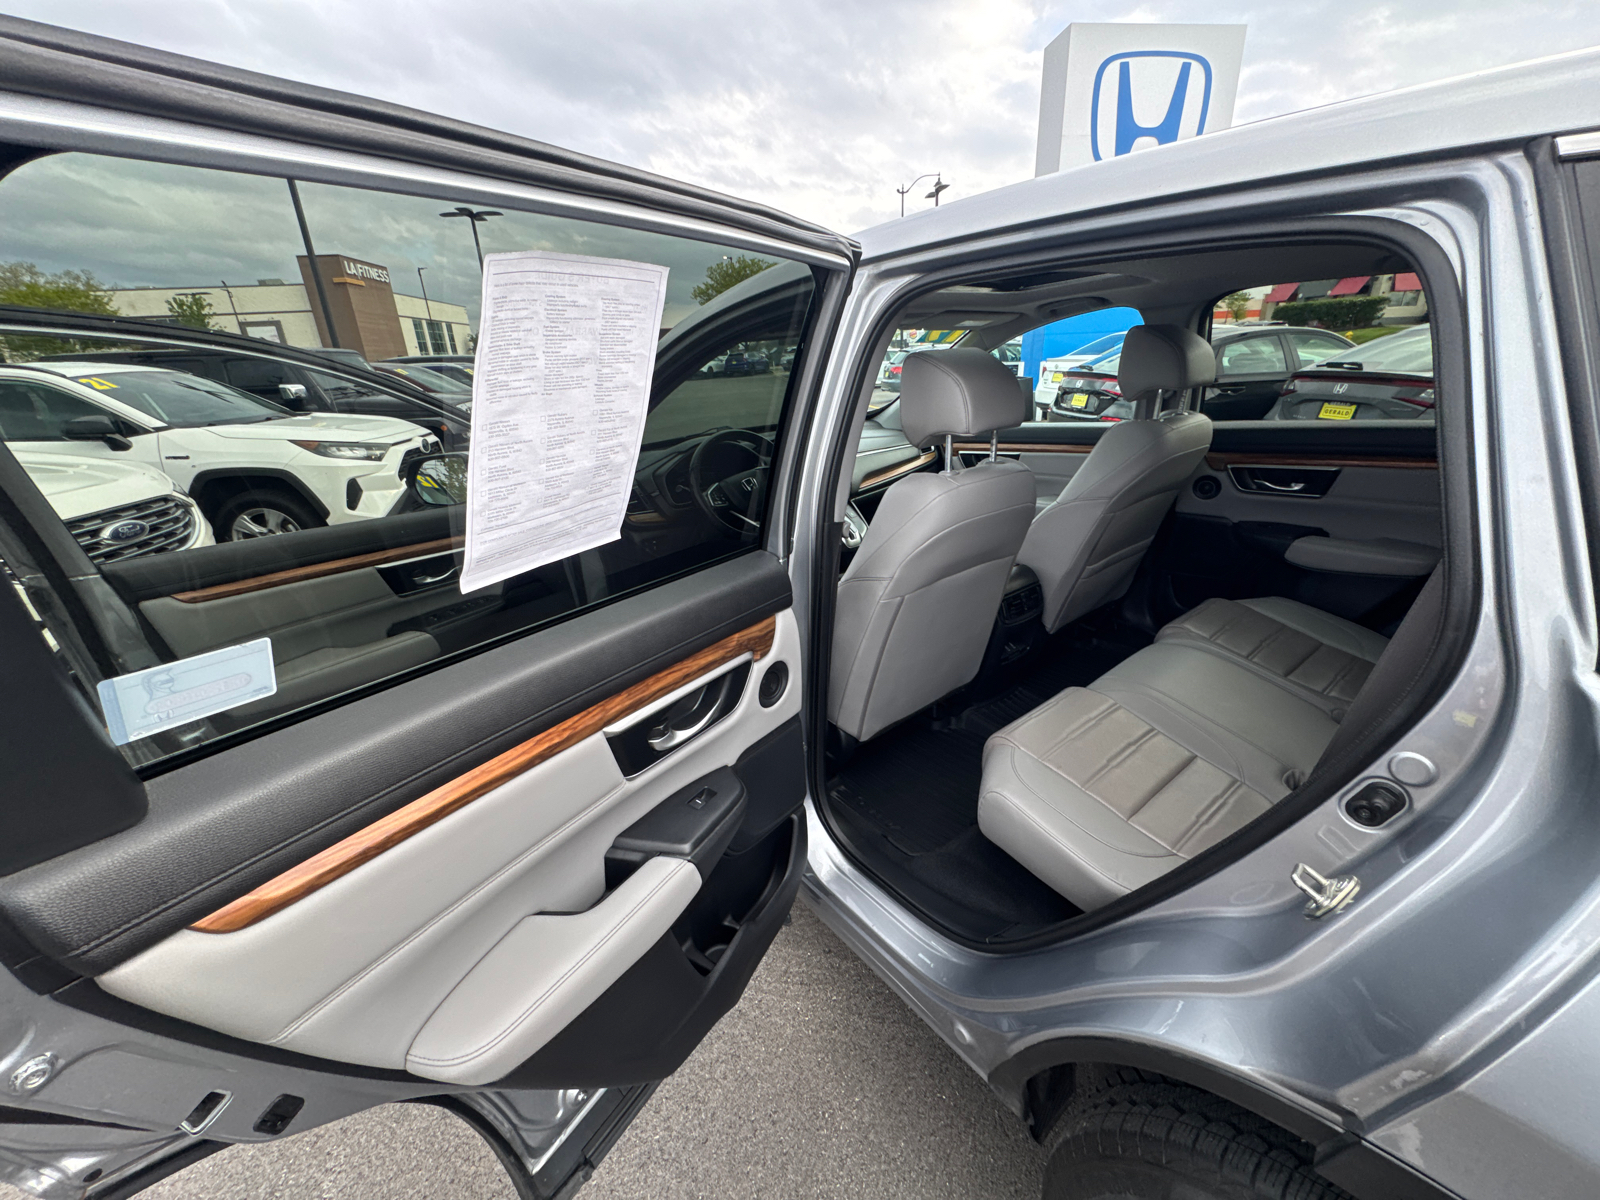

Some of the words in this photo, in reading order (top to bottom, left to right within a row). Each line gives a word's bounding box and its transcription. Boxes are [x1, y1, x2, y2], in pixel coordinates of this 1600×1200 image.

[343, 260, 358, 276] LA
[358, 263, 390, 283] FITNESS
[78, 377, 118, 390] 21
[1324, 408, 1350, 416] GERALD
[118, 524, 141, 539] Ford
